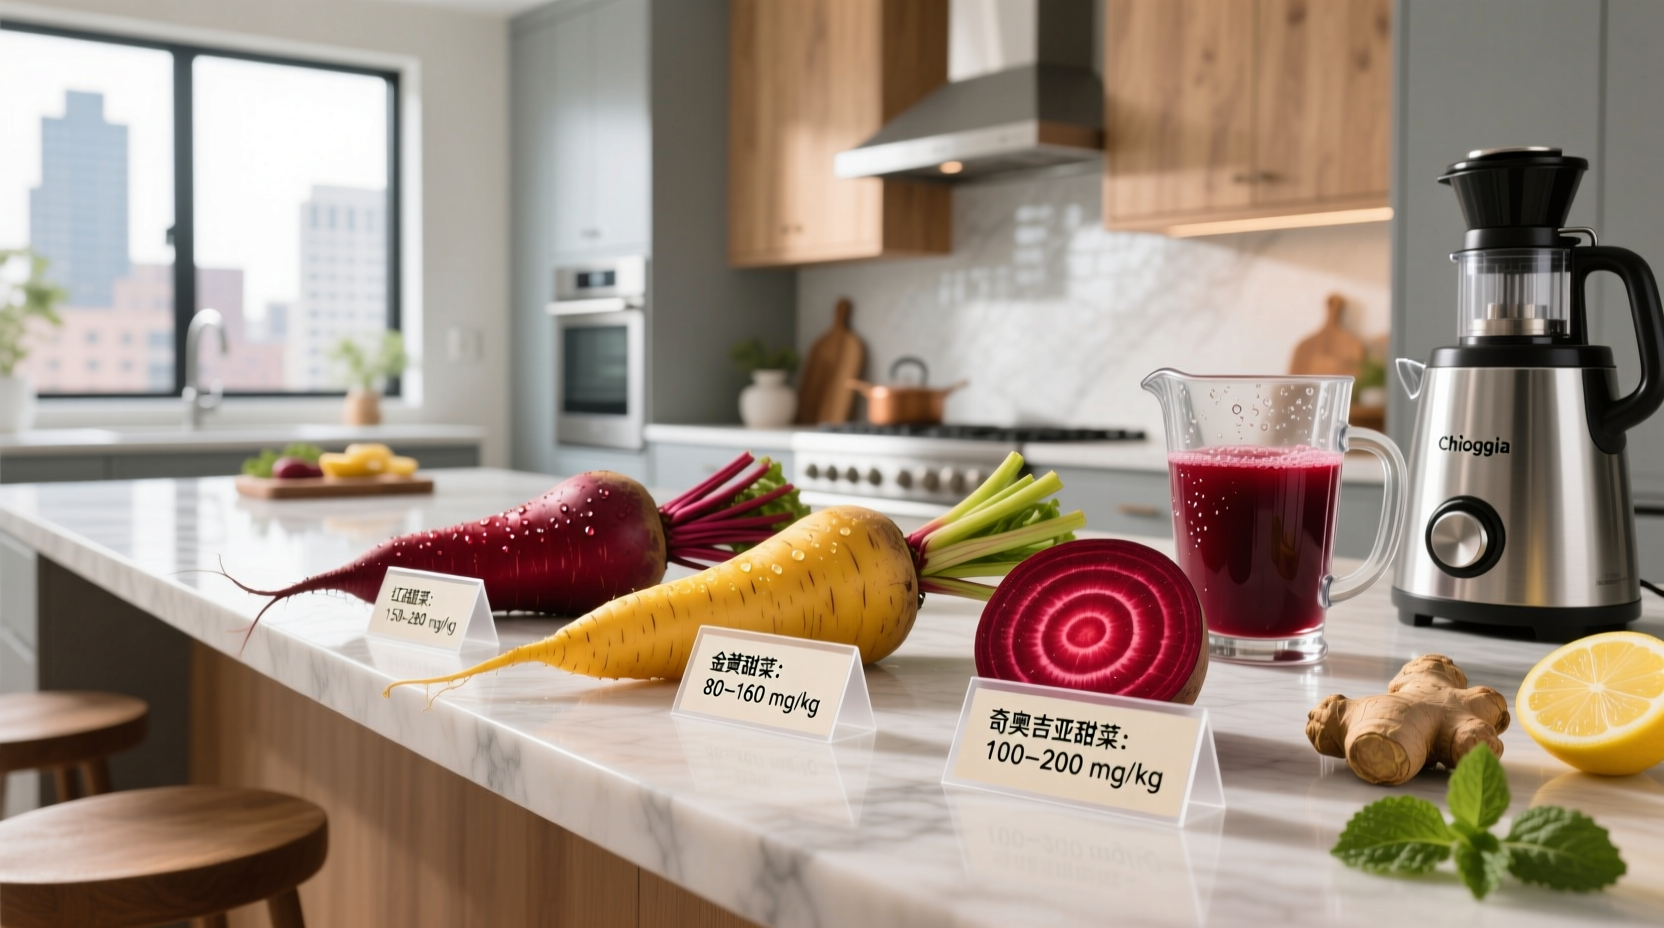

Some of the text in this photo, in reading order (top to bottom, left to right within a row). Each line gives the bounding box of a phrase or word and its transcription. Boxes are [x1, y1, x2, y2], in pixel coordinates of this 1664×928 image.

[1439, 434, 1511, 457] Chioggia
[703, 678, 821, 719] 80–160 mg/kg
[989, 708, 1129, 750] 奇奥吉亚甜菜：
[986, 740, 1163, 794] 100–200 mg/kg
